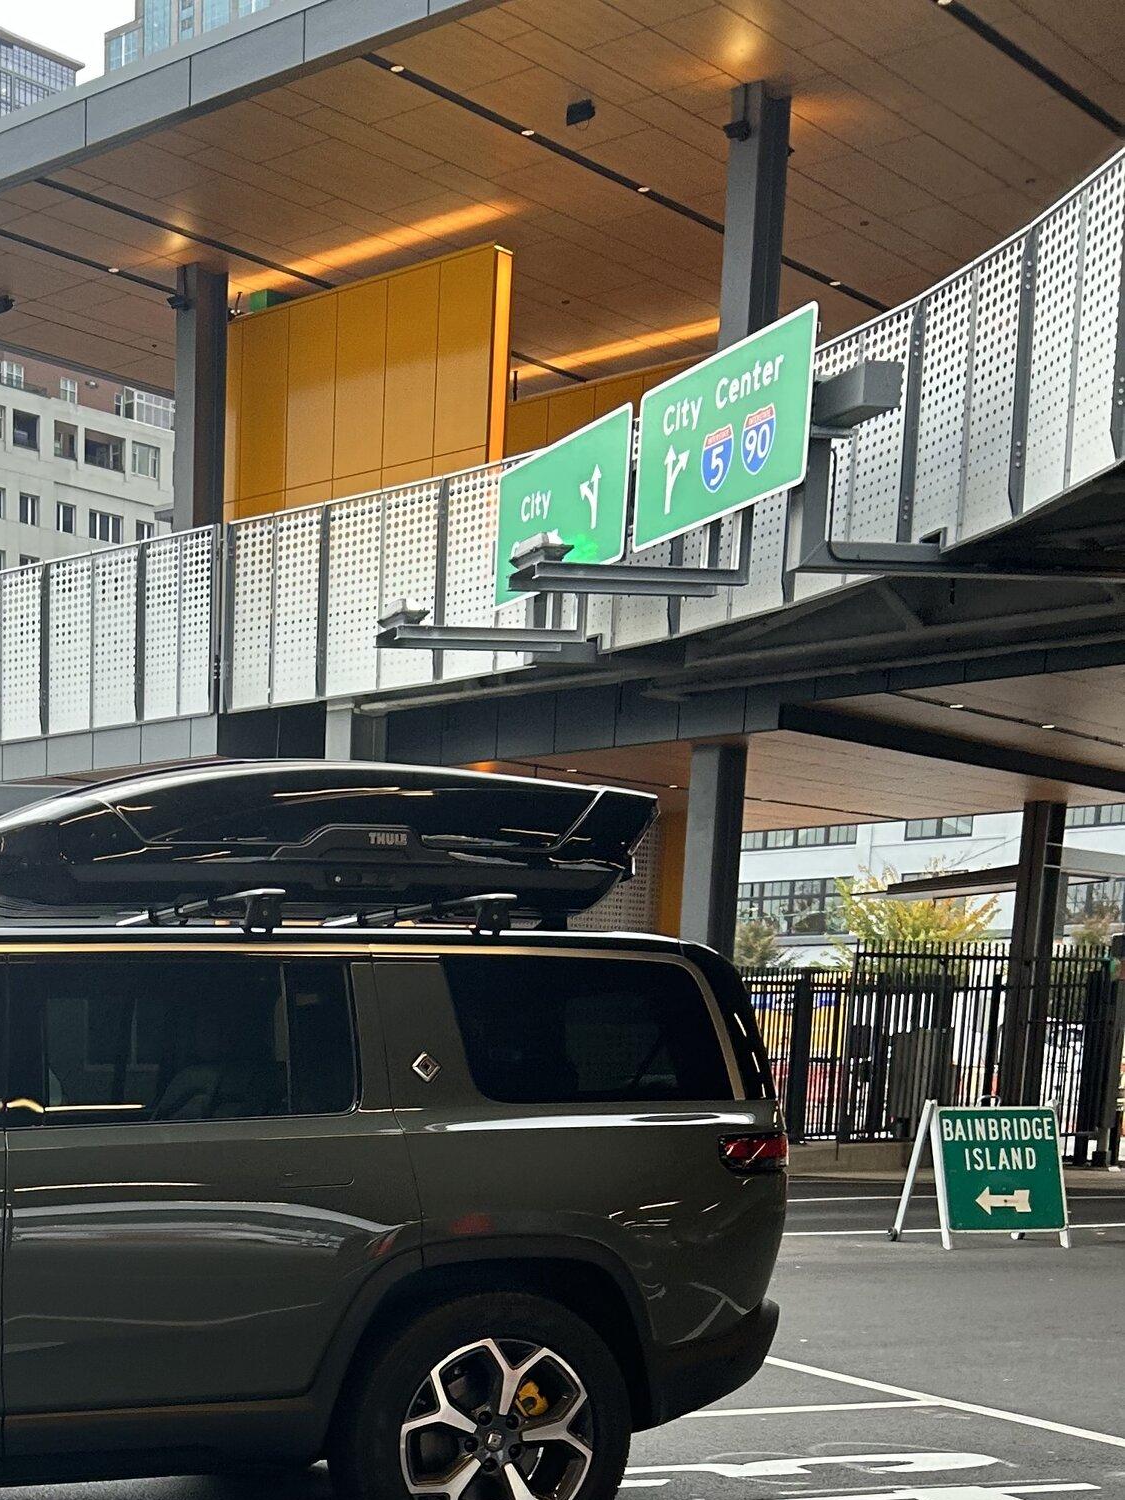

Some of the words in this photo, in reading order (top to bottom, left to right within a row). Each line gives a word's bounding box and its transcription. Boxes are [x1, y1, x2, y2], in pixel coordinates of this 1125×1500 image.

[662, 396, 703, 436] City
[715, 354, 784, 410] Center
[709, 444, 724, 486] 5
[744, 423, 771, 464] 90
[520, 489, 552, 523] City
[368, 831, 408, 846] THULE
[941, 1117, 1055, 1142] BAINBRIDGE
[964, 1147, 1037, 1171] ISLAND
